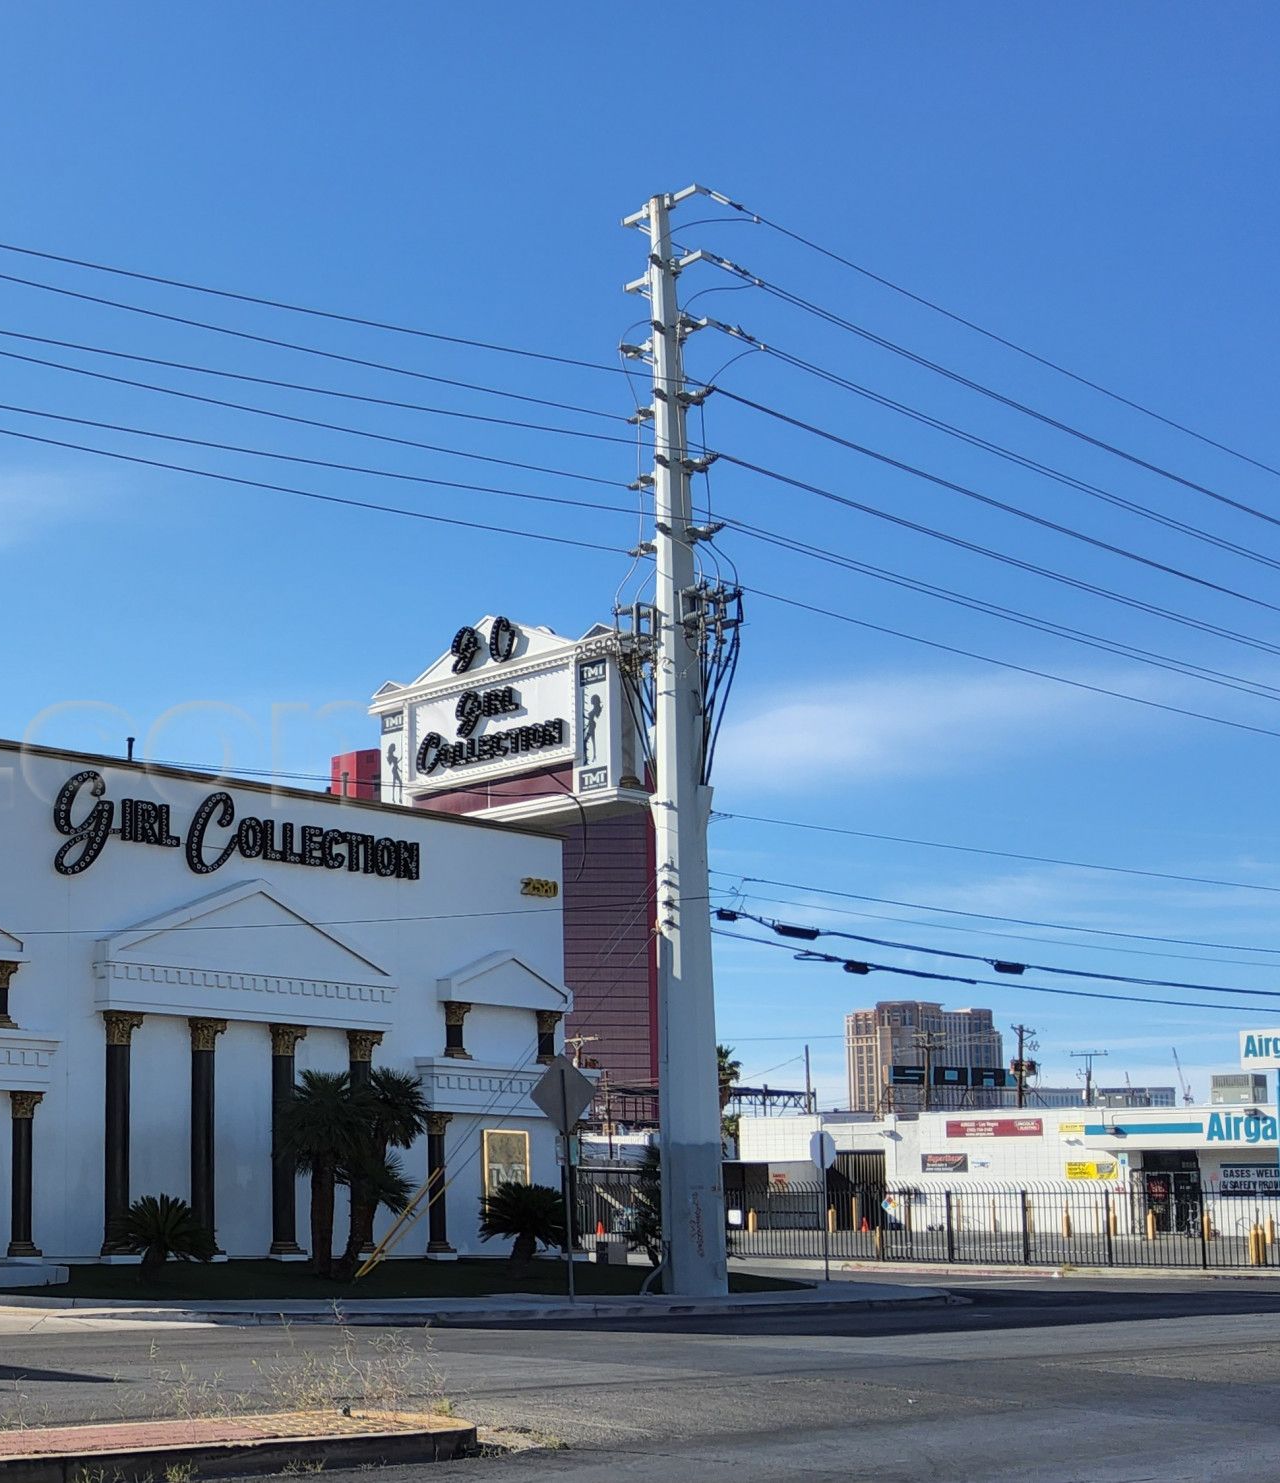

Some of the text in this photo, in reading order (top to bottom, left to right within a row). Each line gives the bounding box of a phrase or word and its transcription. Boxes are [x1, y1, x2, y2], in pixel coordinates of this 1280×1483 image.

[581, 663, 605, 677] TMT
[581, 770, 607, 785] TMT
[54, 770, 420, 880] GIRL COLLECTION
[520, 877, 559, 898] 2580
[1222, 1169, 1250, 1177] GASES
